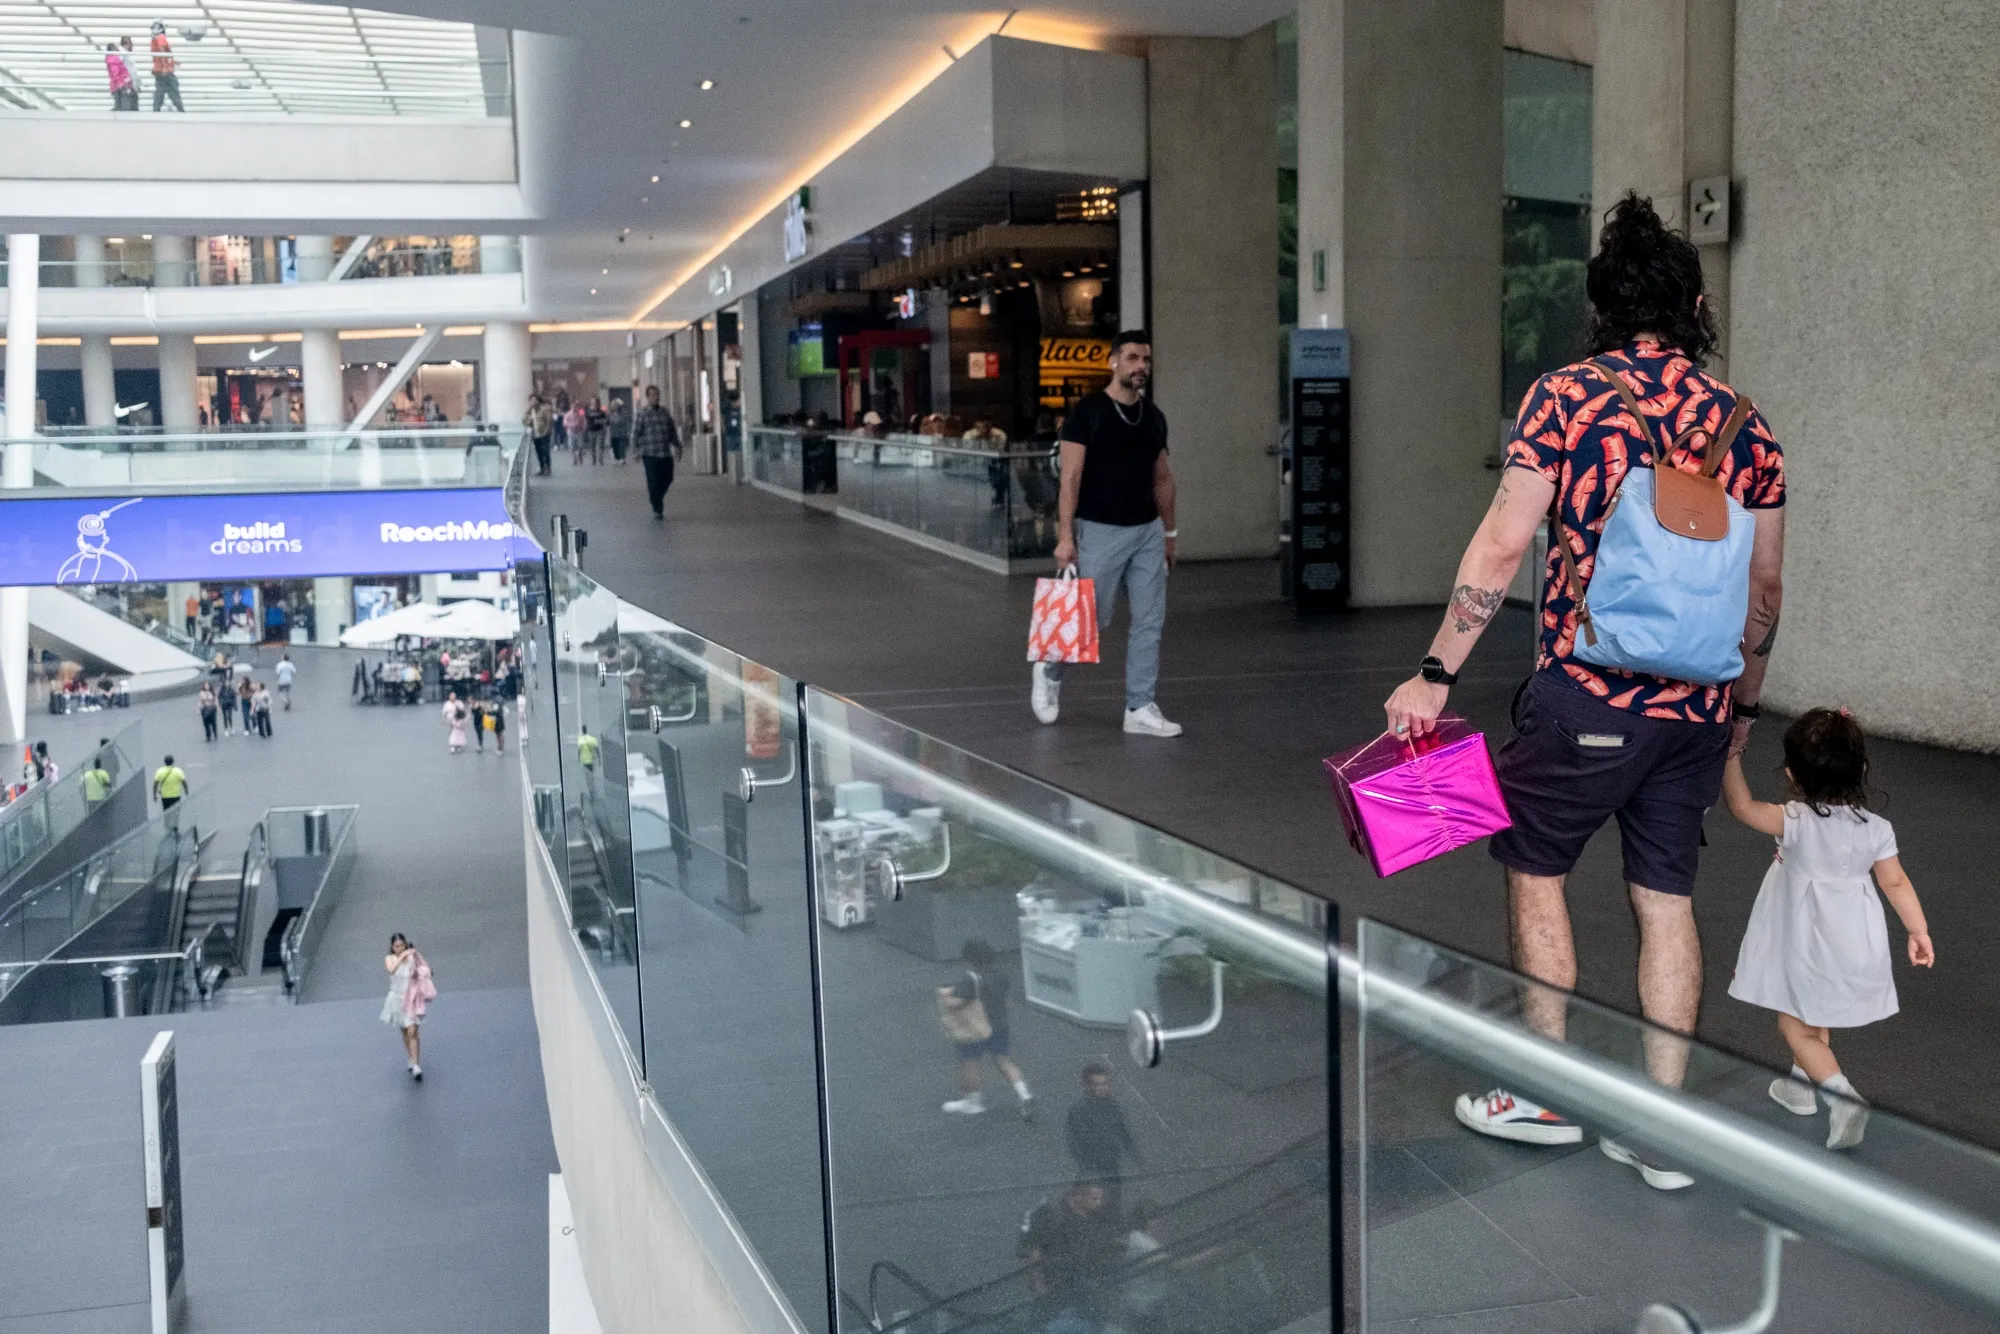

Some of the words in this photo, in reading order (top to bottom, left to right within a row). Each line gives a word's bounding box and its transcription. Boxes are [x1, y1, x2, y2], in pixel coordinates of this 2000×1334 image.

[1040, 339, 1111, 361] lace
[224, 521, 285, 540] build
[210, 538, 302, 555] dreams
